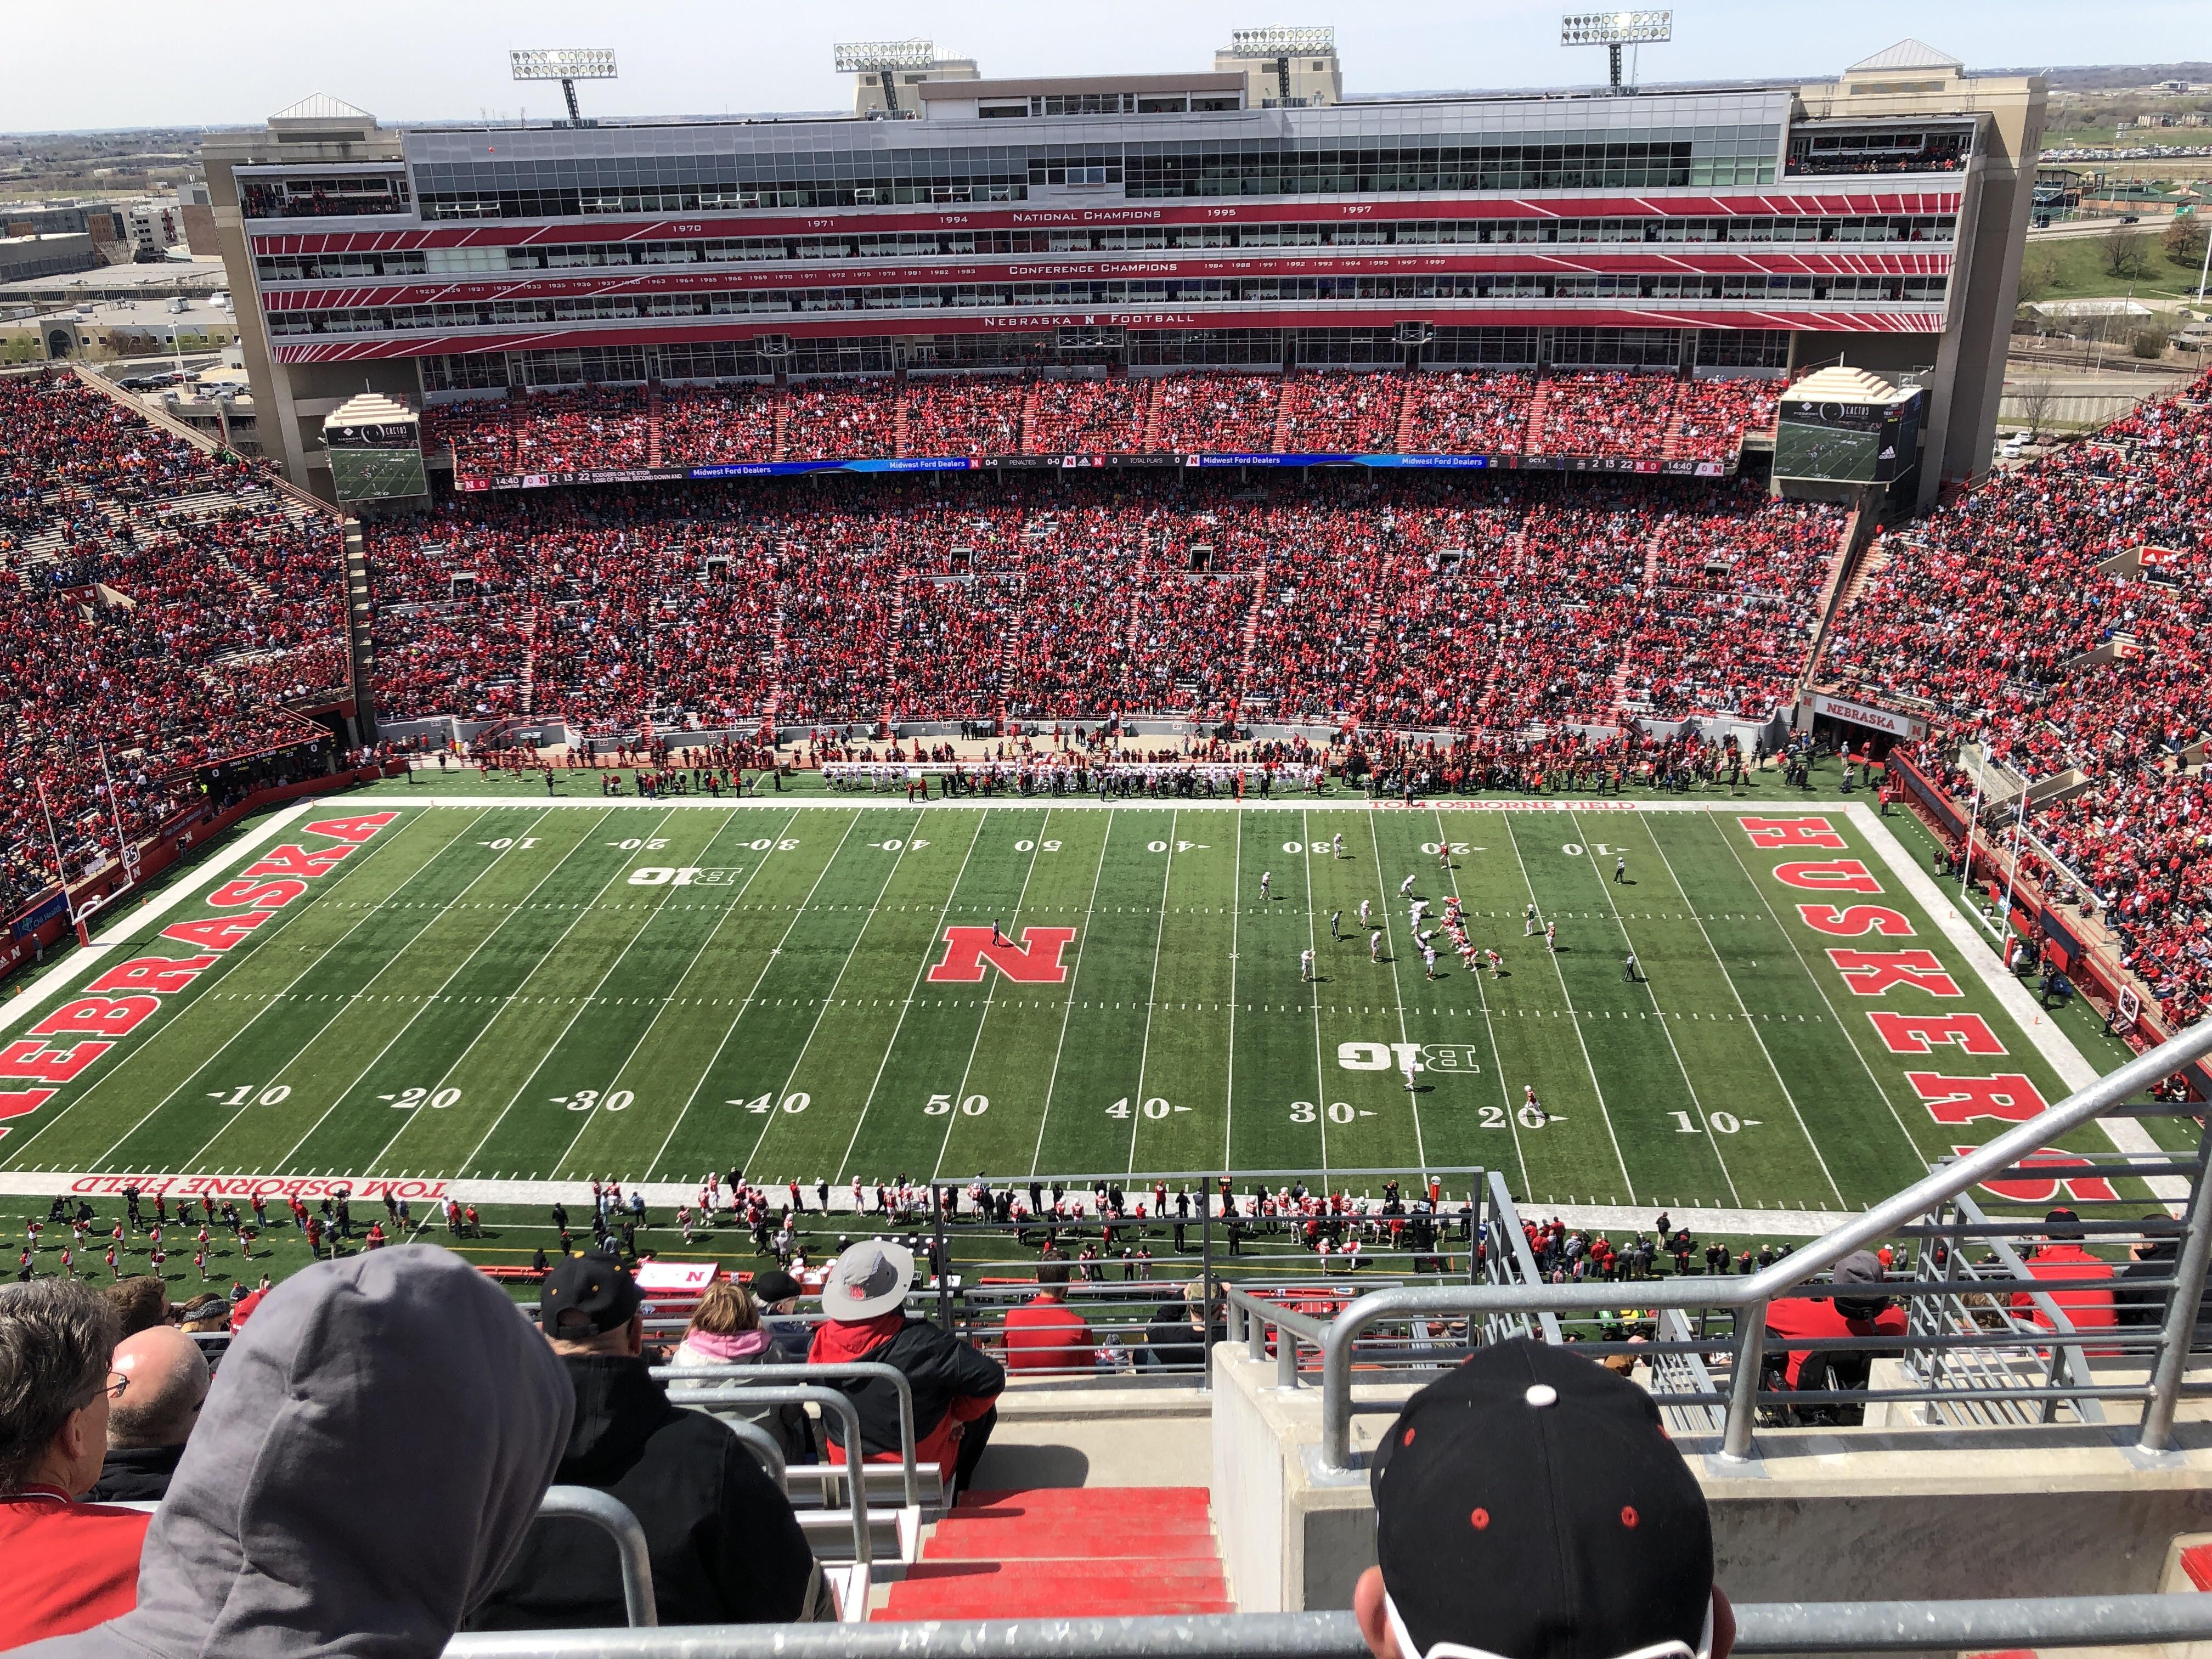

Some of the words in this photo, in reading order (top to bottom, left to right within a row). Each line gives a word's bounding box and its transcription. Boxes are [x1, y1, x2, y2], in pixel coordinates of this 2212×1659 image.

[1013, 212, 1079, 222] NATIONAL
[1083, 210, 1161, 220] CHAMPIONS
[1009, 265, 1095, 275] CONFERENCE
[1101, 263, 1177, 273] CHAMPIONS
[985, 317, 1071, 326] NEBRASKA
[1085, 315, 1094, 325] N
[1110, 314, 1195, 324] FOOTBALL
[1846, 406, 1870, 416] CACTUS
[385, 426, 407, 435] CACTUS
[889, 461, 917, 469] Midwest
[919, 460, 936, 469] Ford
[938, 460, 966, 468] Dealers
[970, 459, 979, 467] N
[1066, 458, 1074, 466] N
[1094, 457, 1102, 465] N
[1190, 456, 1198, 465] N
[1592, 459, 1599, 467] 2
[1605, 460, 1615, 468] 13
[1620, 460, 1633, 469] 22
[1635, 461, 1645, 471] N
[1668, 461, 1692, 470] 14:40
[693, 468, 723, 477] Midwest
[725, 467, 741, 476] Ford
[742, 466, 771, 475] Dealers
[1713, 465, 1723, 473] N
[495, 477, 518, 485] 14:40
[551, 475, 558, 483] 2
[578, 472, 591, 481] 22
[465, 480, 475, 489] N
[84, 589, 95, 598] N
[1803, 696, 1813, 708] N
[1826, 702, 1895, 730] NEBRASKA
[1911, 725, 1922, 737] N
[255, 749, 276, 759] 14:40
[310, 744, 318, 752] 0
[212, 769, 219, 777] 0
[1435, 801, 1556, 810] OSBORNE
[1564, 802, 1636, 810] FIELD
[184, 831, 193, 843] N
[489, 837, 542, 849] 10
[618, 838, 672, 850] 20
[749, 838, 800, 850] 30
[882, 839, 931, 851] 40
[1014, 839, 1063, 852] 50
[1147, 840, 1195, 853] 40
[1283, 841, 1331, 854] 30
[1420, 842, 1471, 855] 20
[1562, 843, 1616, 856] 10
[133, 866, 141, 878] N
[33, 916, 44, 927] CHI
[43, 904, 62, 921] Health
[10, 945, 21, 959] N
[926, 926, 1078, 983] N
[0, 812, 402, 1141] EBRASKA
[220, 1085, 292, 1107] 10
[389, 1088, 462, 1109] 20
[566, 1090, 635, 1112] 30
[744, 1092, 812, 1114] 40
[923, 1093, 990, 1116] 50
[1104, 1097, 1169, 1120] 40
[1289, 1101, 1355, 1124] 30
[1477, 1105, 1547, 1130] 20
[1667, 1109, 1741, 1134] 10
[71, 1175, 179, 1194] FIELD
[178, 1177, 354, 1197] OSBORNE
[354, 1180, 449, 1199] TOM
[686, 1271, 705, 1283] N
[850, 1285, 865, 1300] N
